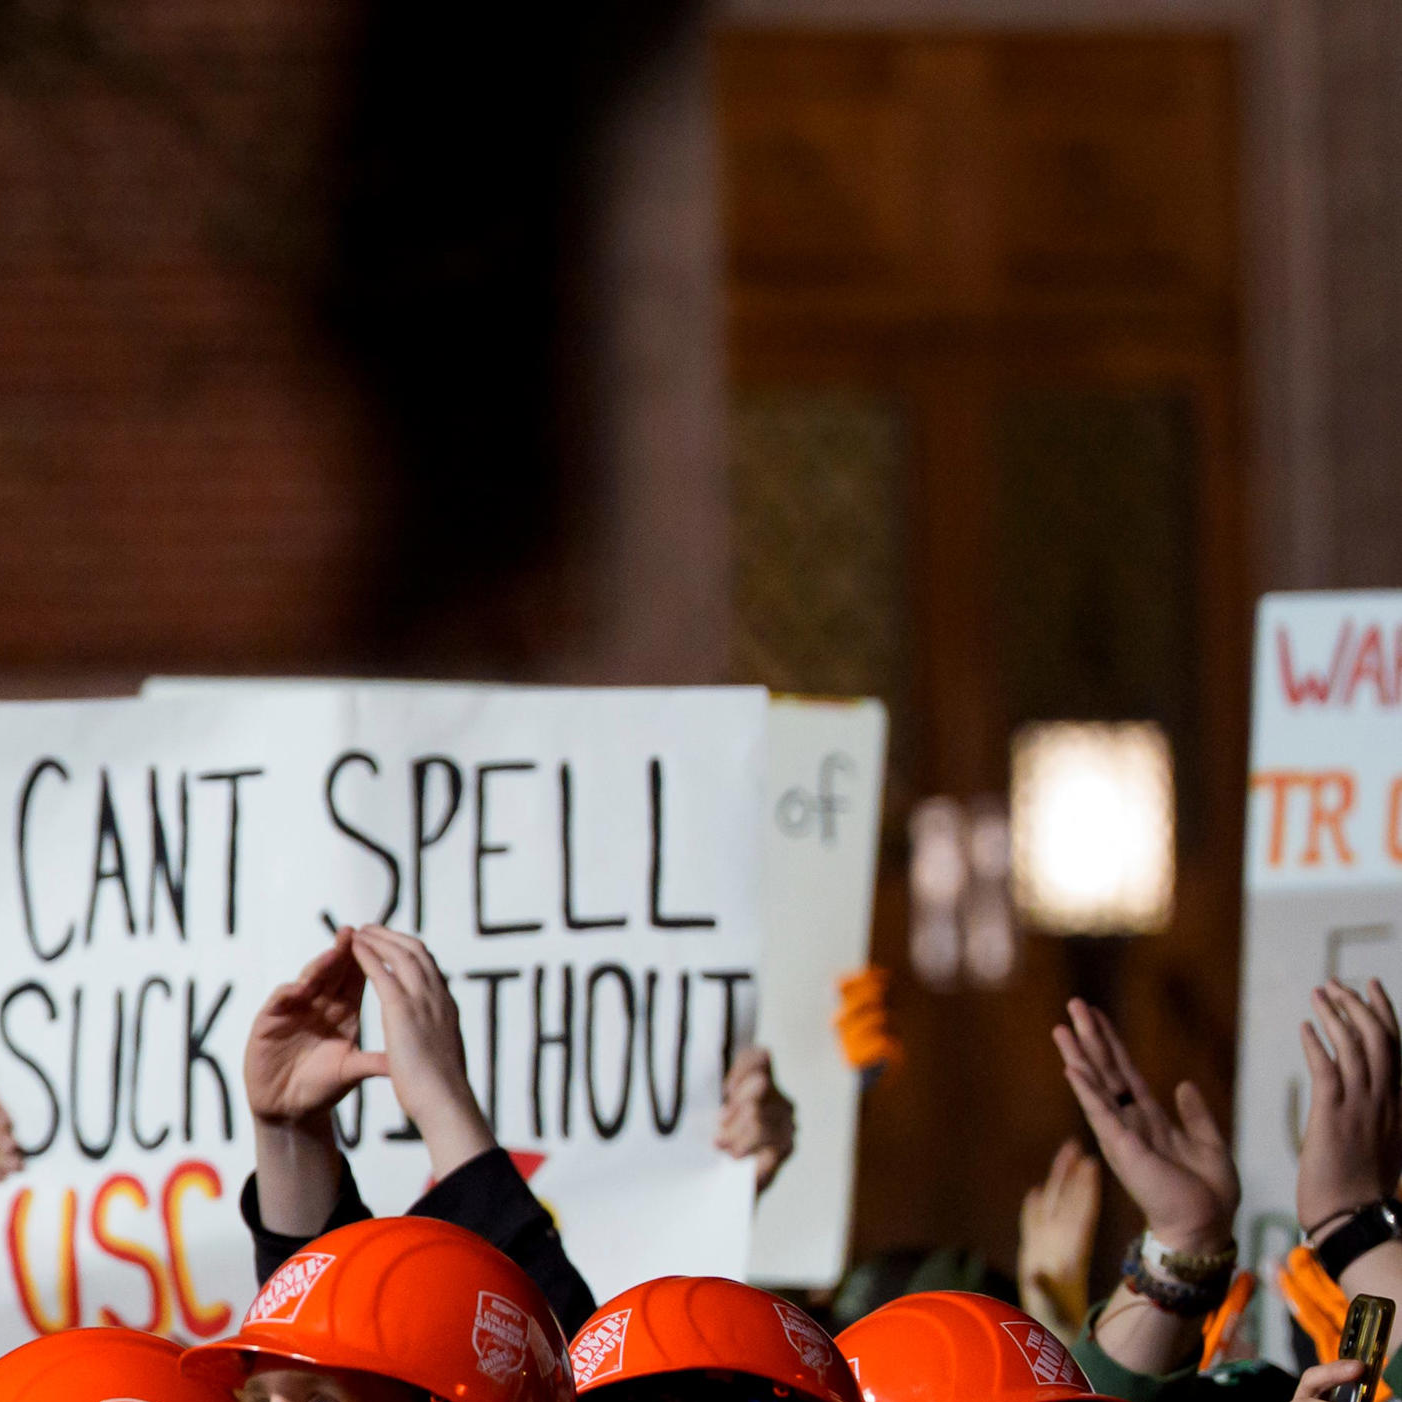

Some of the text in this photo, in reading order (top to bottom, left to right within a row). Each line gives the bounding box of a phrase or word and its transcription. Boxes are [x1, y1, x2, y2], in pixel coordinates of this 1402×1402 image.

[1275, 618, 1402, 708] WA
[16, 750, 718, 963] CANT SPELL
[773, 750, 851, 847] of
[1251, 770, 1402, 868] TR
[334, 963, 752, 1150] THOUT
[5, 1159, 233, 1342] USC
